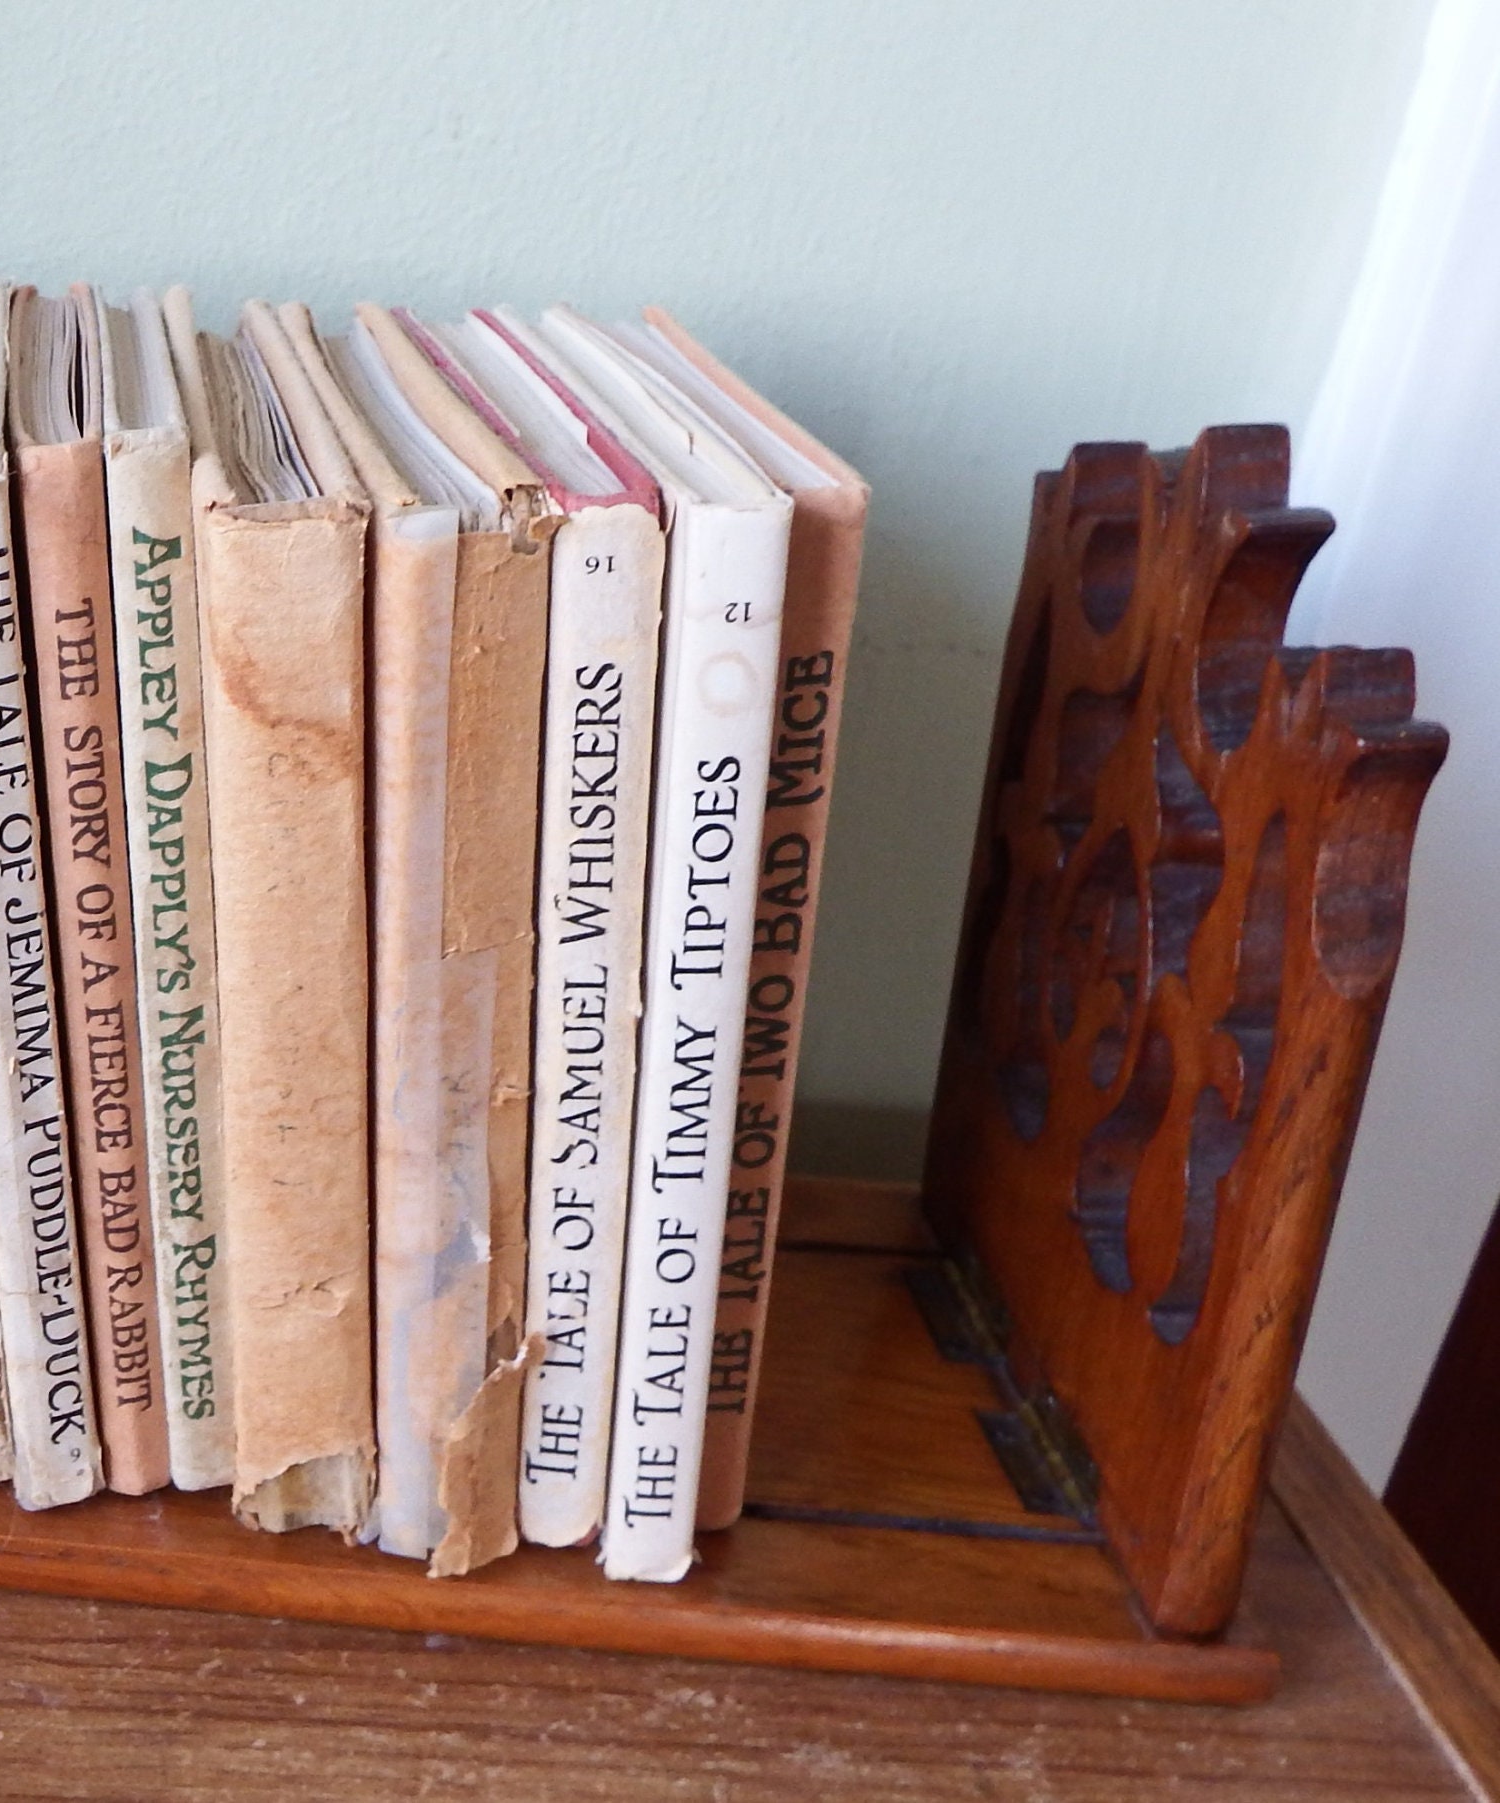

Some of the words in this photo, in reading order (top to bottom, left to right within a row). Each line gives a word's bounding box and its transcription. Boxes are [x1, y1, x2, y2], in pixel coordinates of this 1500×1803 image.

[585, 555, 617, 575] 16
[724, 602, 753, 623] 12
[55, 597, 98, 701] THE
[132, 527, 181, 741] APPLEY
[63, 725, 111, 869] STORY
[765, 650, 833, 813] MICE
[553, 661, 622, 946] WHISKERS
[75, 883, 117, 943] OF
[144, 752, 196, 994] DAPPLY'S
[669, 755, 741, 991] TIPTOES
[754, 832, 810, 954] BAD
[4, 897, 54, 1102] JEMIMA
[81, 953, 119, 992] A
[86, 1000, 134, 1153] FIERCE
[158, 1004, 205, 1223] NURSERY
[551, 963, 608, 1169] SAMUEL
[652, 1016, 717, 1194] TIMMY
[732, 1103, 779, 1169] OF
[99, 1168, 140, 1253] BAD
[552, 1187, 595, 1251] OF
[657, 1217, 697, 1284] OF
[107, 1267, 152, 1412] RABBIT
[173, 1235, 217, 1421] RHYMES
[633, 1302, 692, 1428] TALE
[526, 1403, 583, 1484] THE
[625, 1444, 678, 1529] THE
